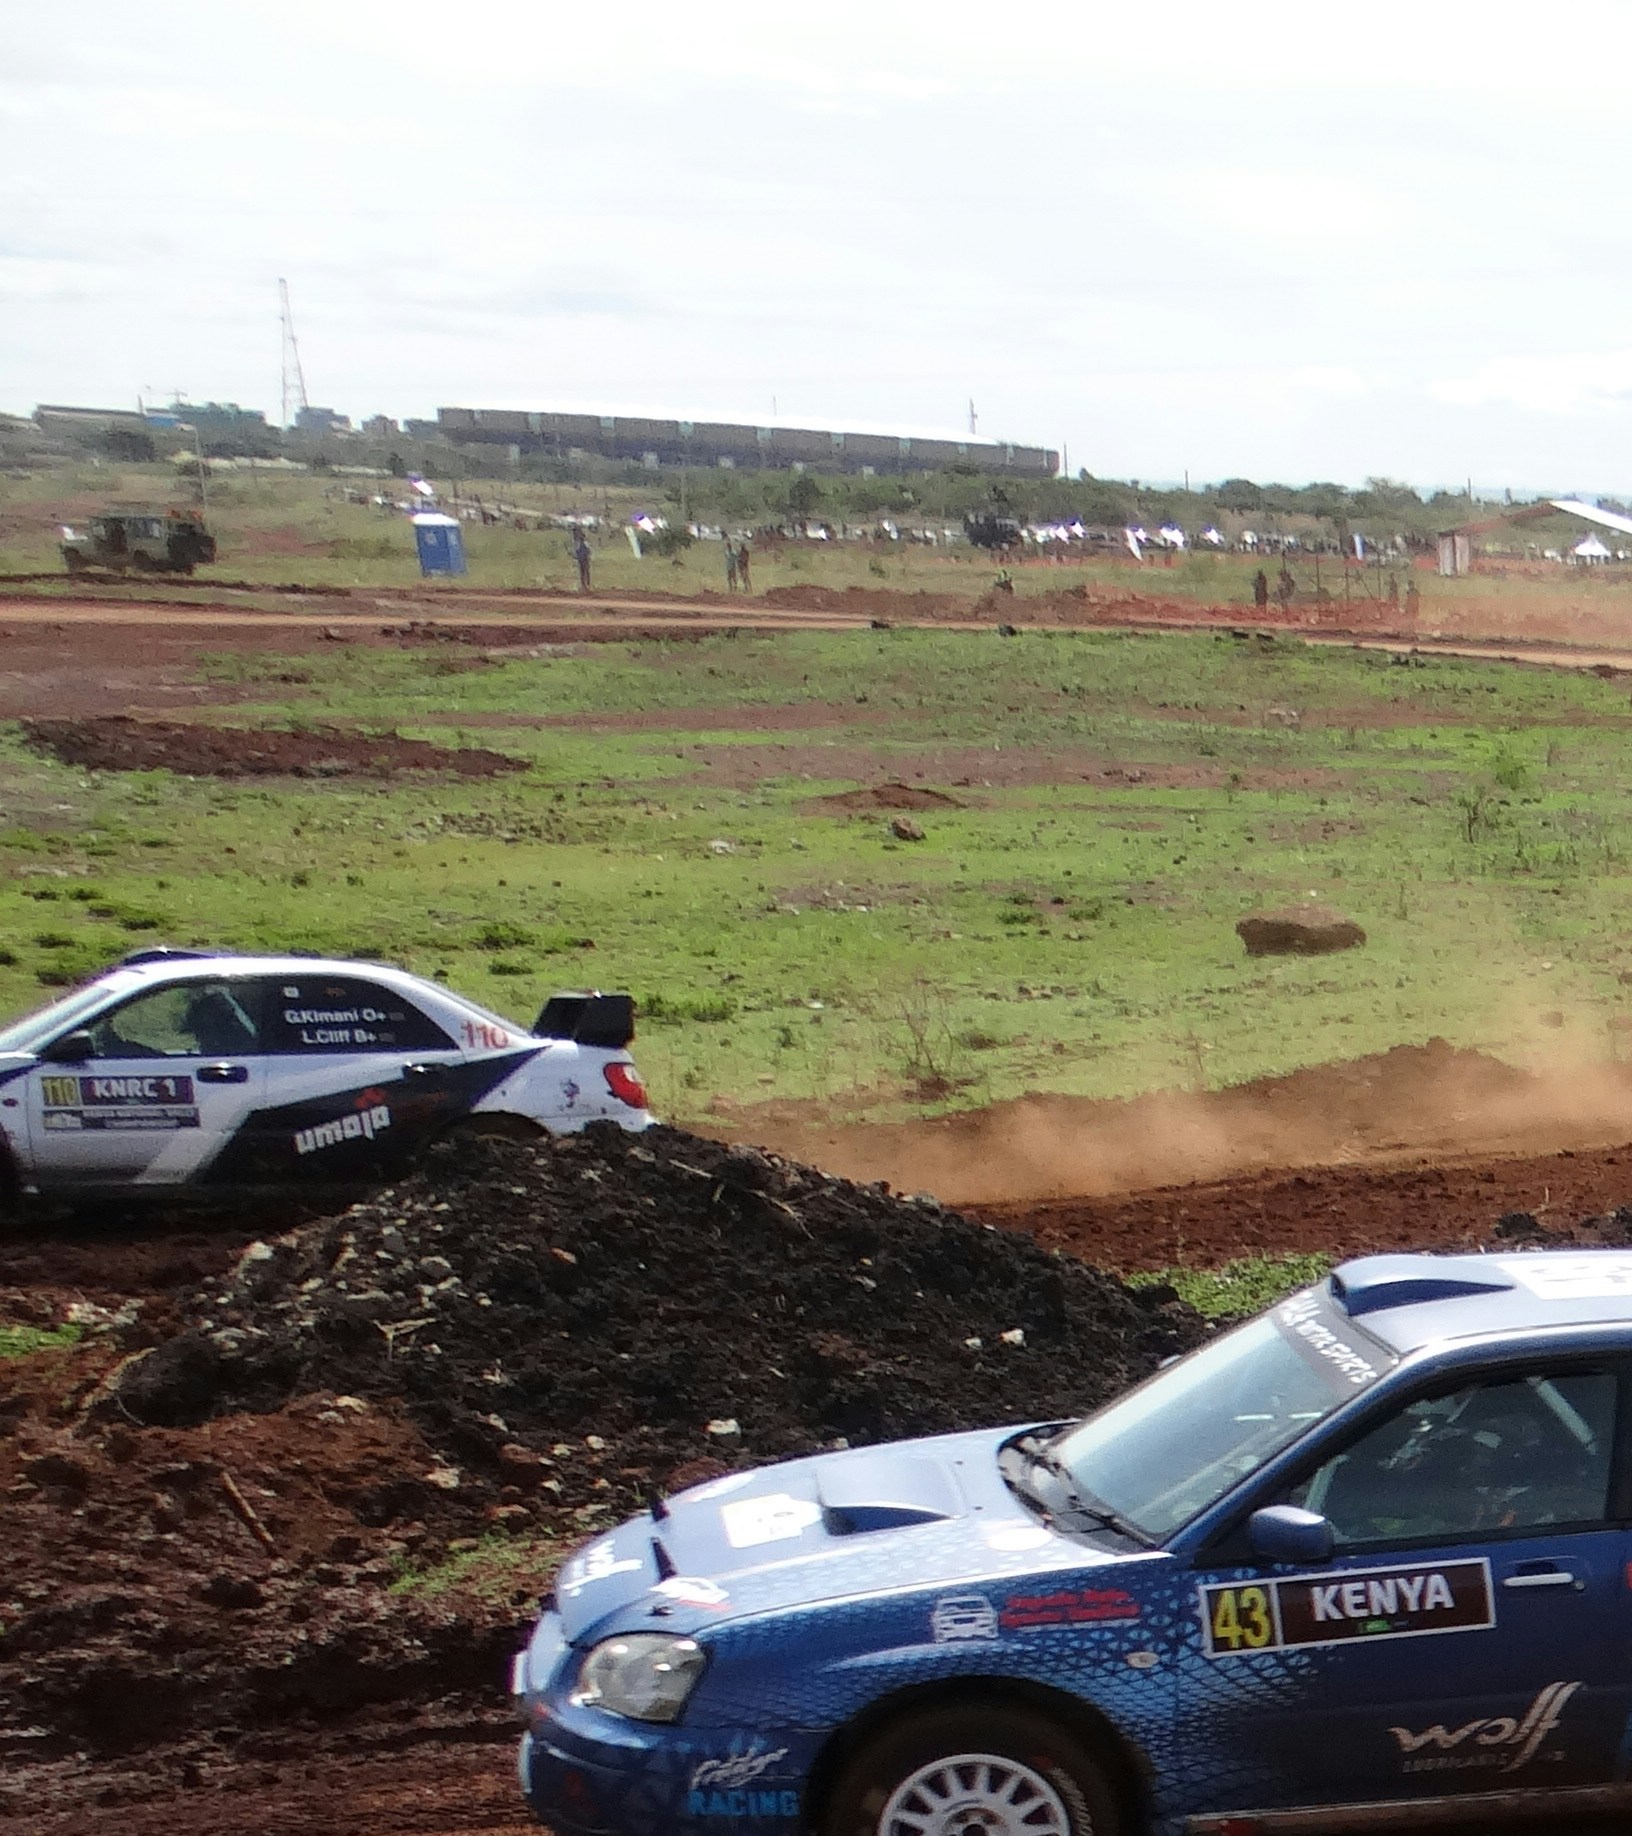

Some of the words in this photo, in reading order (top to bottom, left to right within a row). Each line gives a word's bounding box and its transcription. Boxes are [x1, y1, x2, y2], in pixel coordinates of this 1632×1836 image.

[362, 1008, 386, 1022] O+
[461, 1020, 509, 1048] 110
[94, 1078, 158, 1098] KNRC
[163, 1079, 176, 1097] 1
[1311, 1574, 1455, 1621] KENYA
[1213, 1587, 1272, 1649] 43
[688, 1790, 799, 1816] RACING
